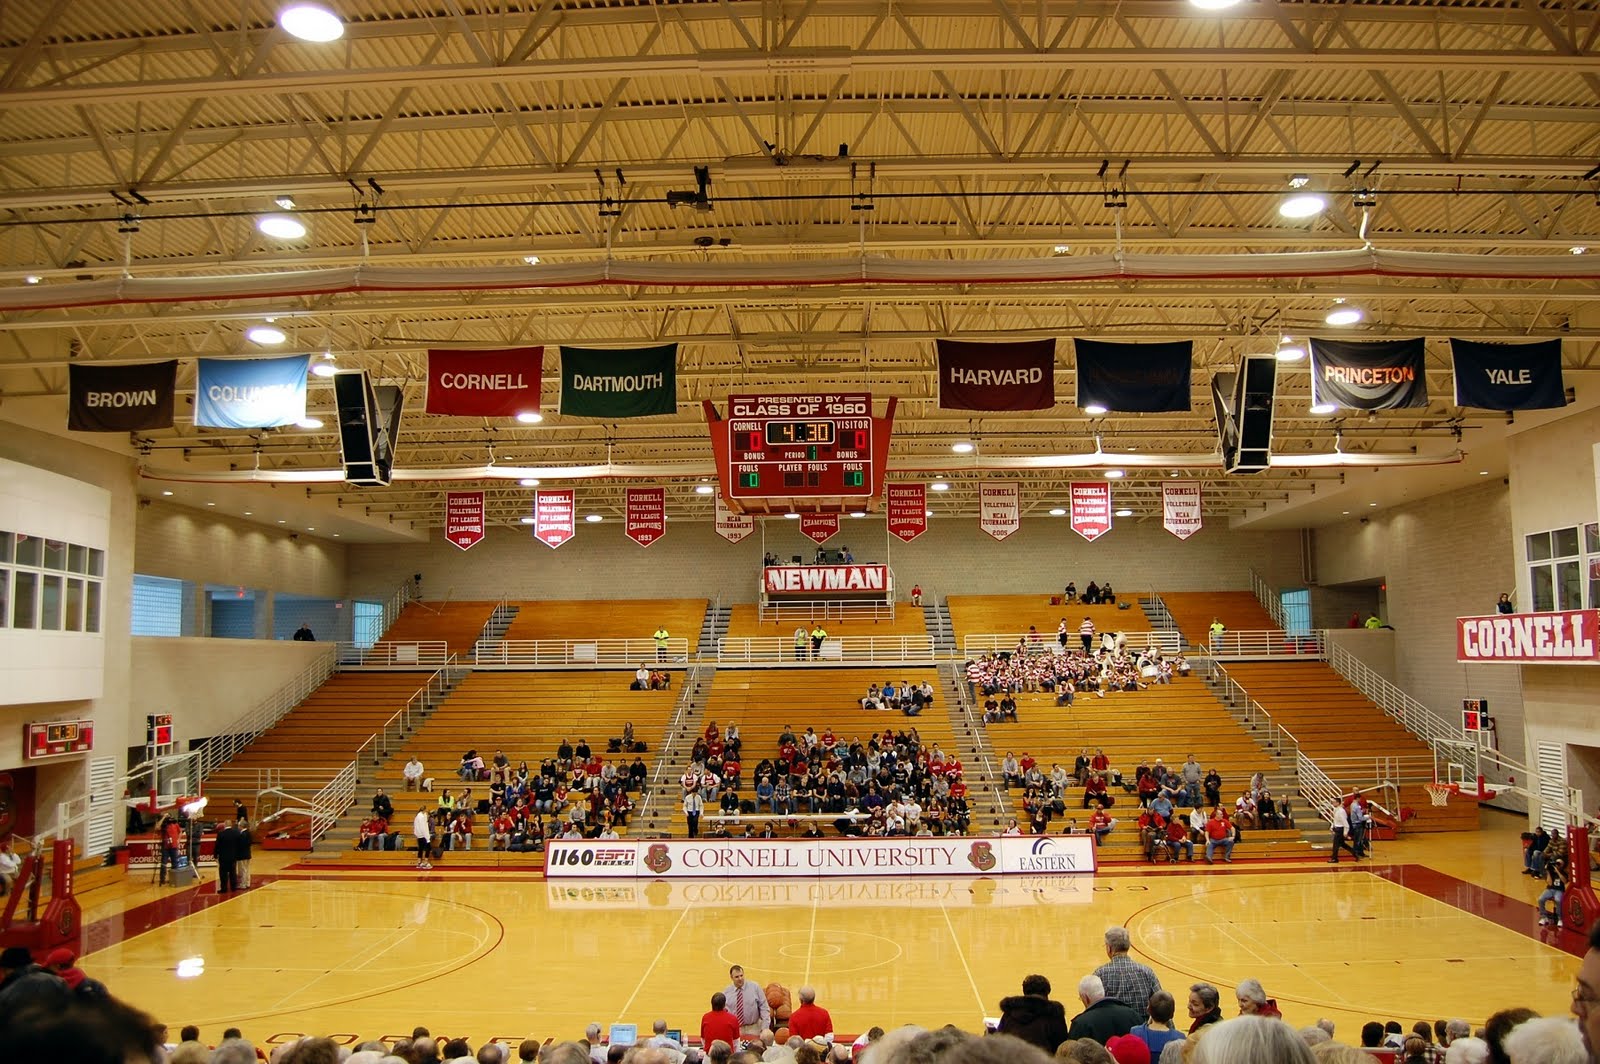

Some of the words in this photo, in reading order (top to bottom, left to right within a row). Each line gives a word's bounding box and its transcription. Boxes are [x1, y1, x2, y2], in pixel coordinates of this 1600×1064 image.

[950, 367, 1043, 386] HARVARD
[1324, 365, 1414, 385] PRINCETON
[1485, 368, 1532, 385] YALE
[440, 373, 529, 390] CORNELL
[573, 372, 663, 392] DARTMOUTH
[87, 389, 157, 408] BROWN
[758, 396, 822, 404] PRESENTED
[825, 395, 841, 403] BY
[733, 404, 791, 416] CLASS
[796, 403, 819, 415] OF
[825, 403, 866, 415] 1960
[733, 421, 762, 431] CORNELL
[836, 420, 869, 430] VISITOR
[743, 452, 766, 460] BONUS
[784, 451, 806, 459] PERIOD
[836, 450, 858, 459] BONUS
[738, 464, 759, 472] FOULS
[778, 463, 803, 472] PLAYER
[807, 463, 828, 471] FOULS
[842, 462, 863, 471] FOULS
[890, 489, 922, 497] CORNELL
[982, 488, 1016, 496] CORNELL
[449, 497, 481, 505] CORNELL
[629, 522, 661, 530] CHAMPIONS
[803, 519, 836, 527] CHAMPIONS
[890, 517, 923, 525] CHAMPIONS
[767, 567, 884, 591] NEWMAN
[1463, 614, 1594, 657] CORNELL
[550, 849, 594, 866] 1160
[595, 849, 636, 860] ESPN
[682, 848, 799, 868] CORNELL
[807, 847, 957, 868] UNIVERSITY
[1019, 856, 1076, 870] EASTERN
